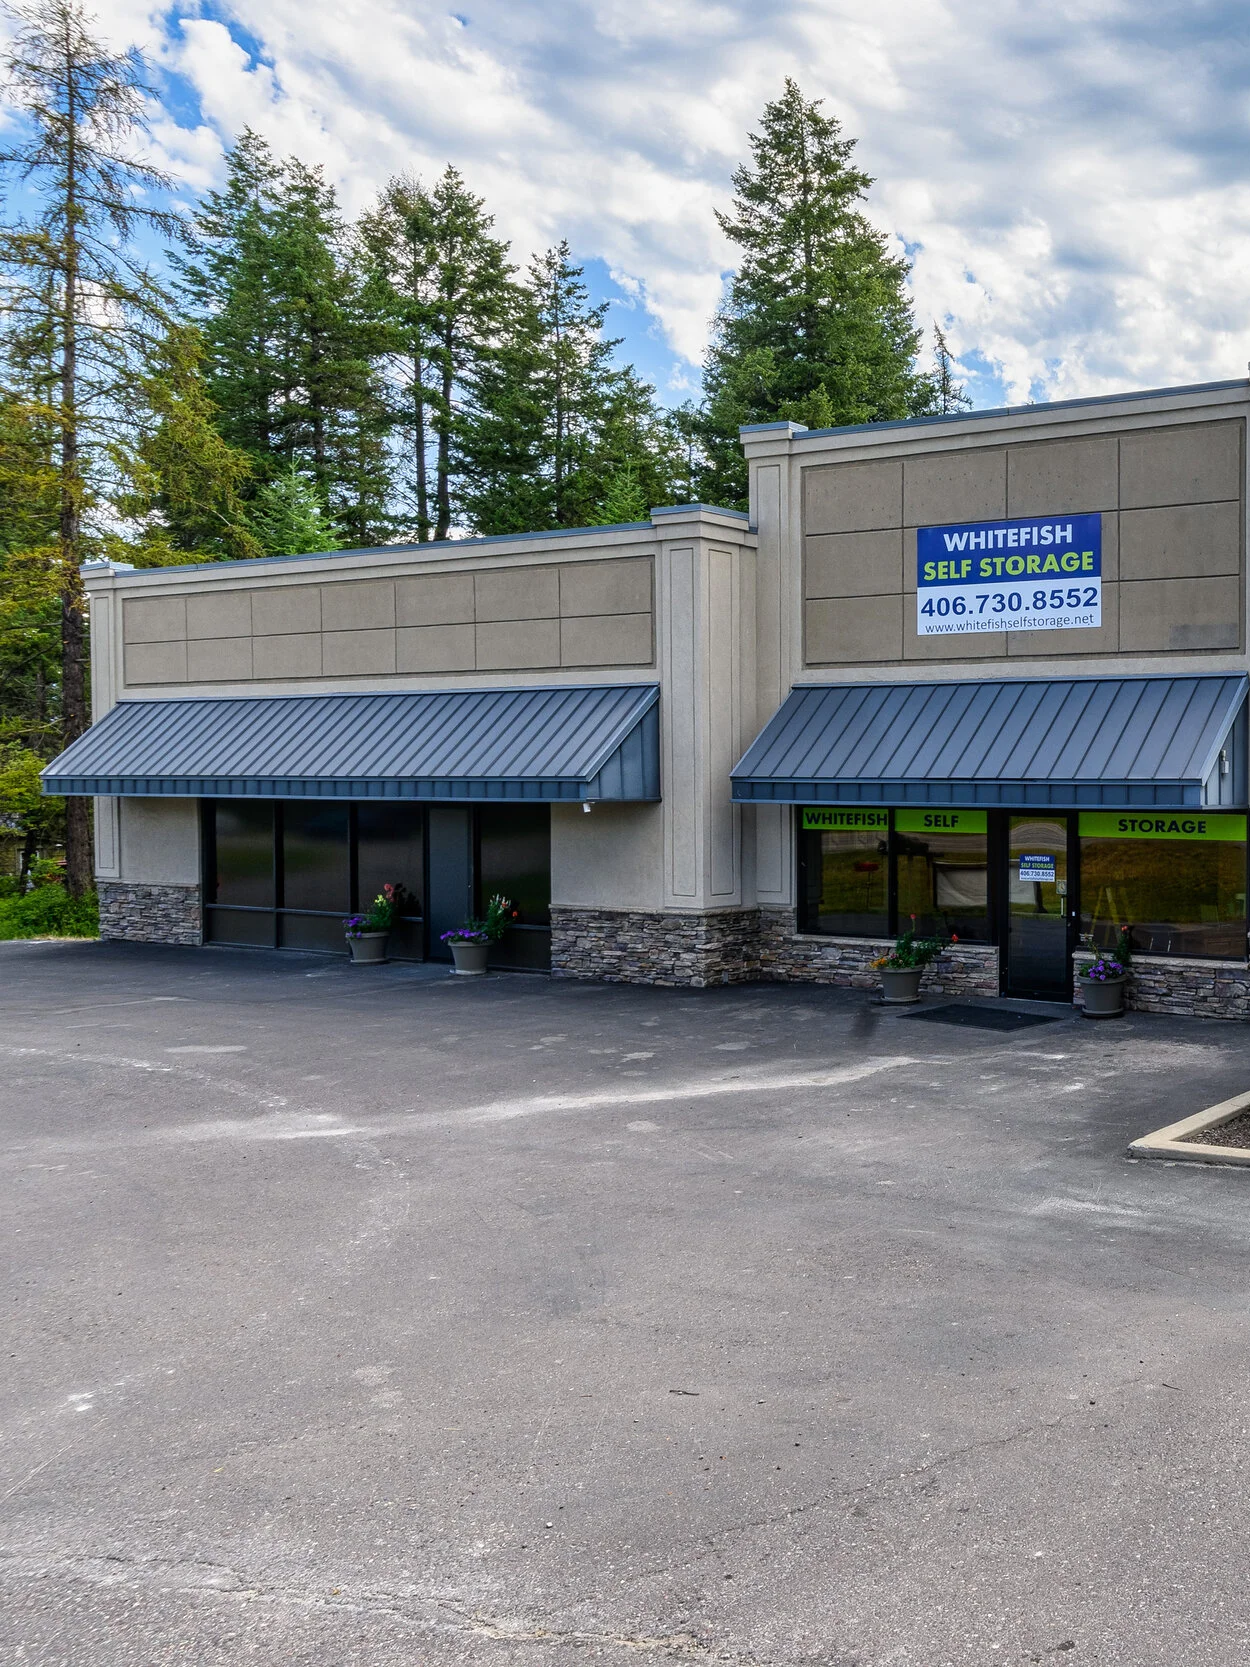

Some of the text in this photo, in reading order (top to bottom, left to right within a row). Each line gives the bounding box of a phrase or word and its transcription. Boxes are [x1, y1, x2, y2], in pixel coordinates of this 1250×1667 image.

[943, 523, 1073, 552] WHITEFISH
[923, 551, 1094, 581] SELF STORAGE
[920, 586, 1098, 617] 406.730.8552
[925, 613, 1095, 633] www.whitefishselfstorage.net
[805, 812, 1207, 834] WHITEFISH SELF STORAGE
